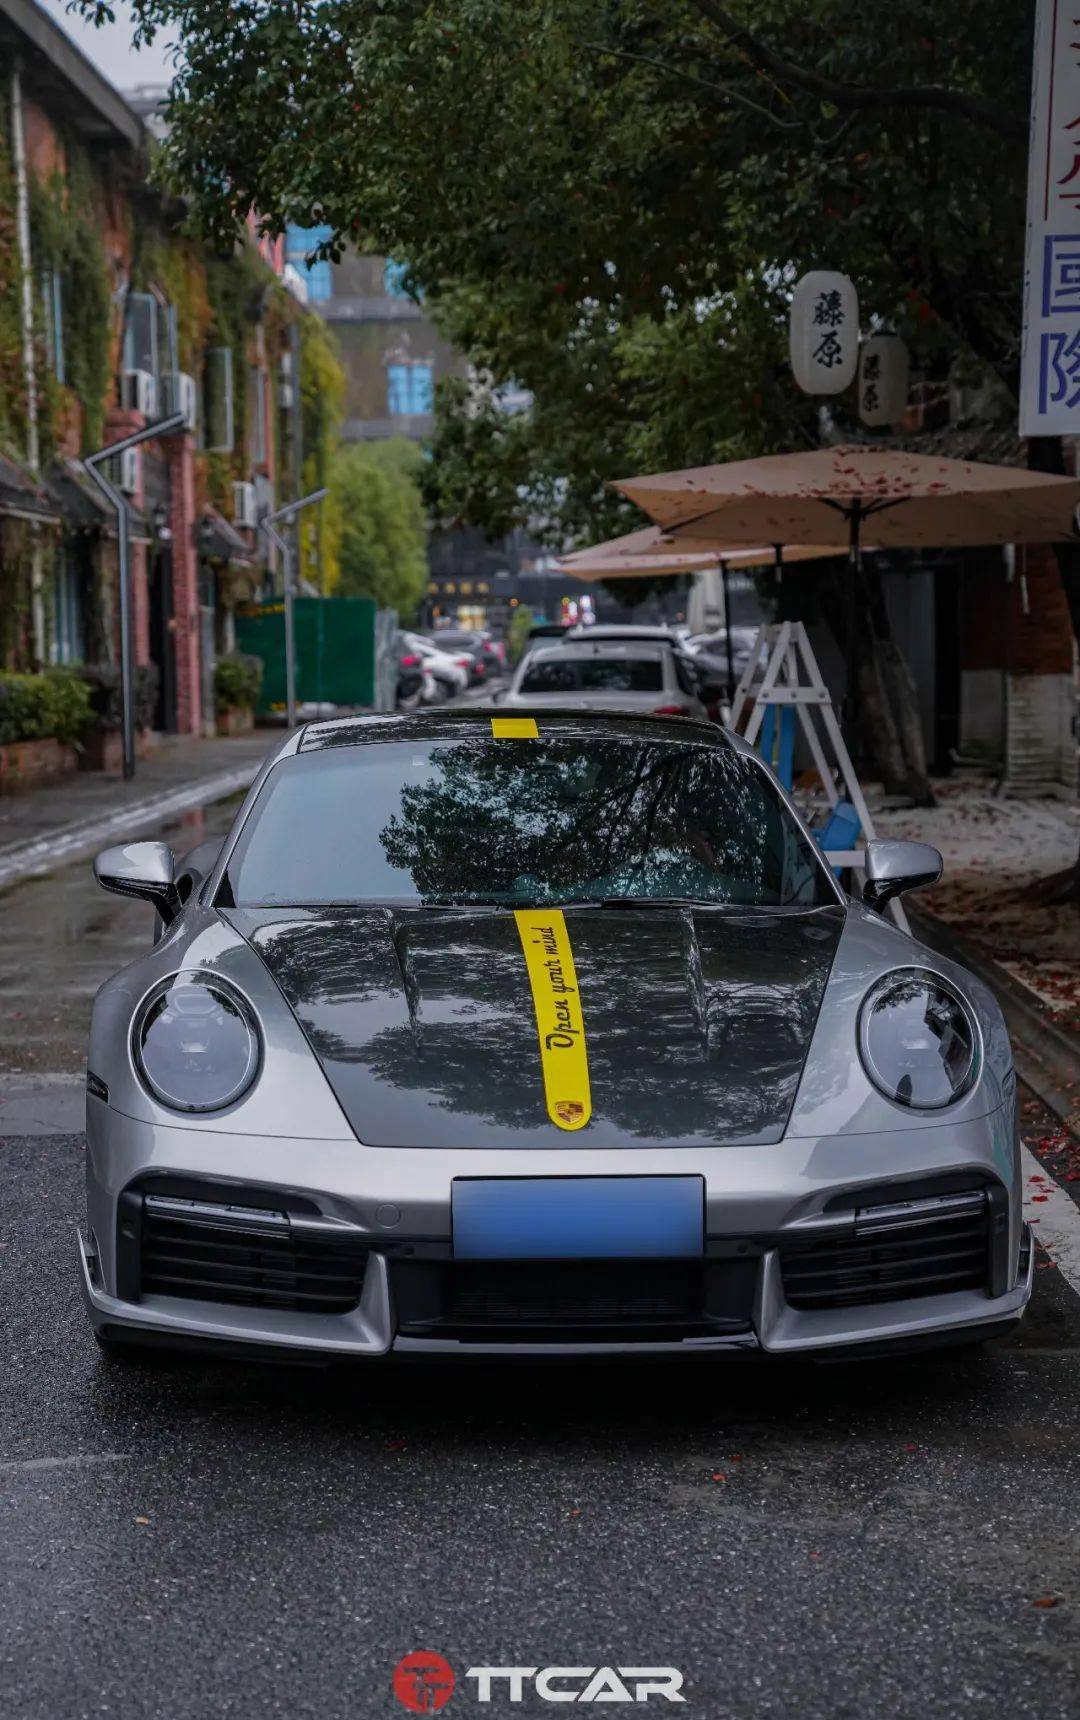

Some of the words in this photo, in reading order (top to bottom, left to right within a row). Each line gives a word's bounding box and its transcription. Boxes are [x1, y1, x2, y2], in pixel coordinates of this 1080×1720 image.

[812, 290, 845, 369] 藤原
[530, 927, 560, 955] mind
[544, 959, 575, 994] your
[545, 1000, 580, 1051] Open
